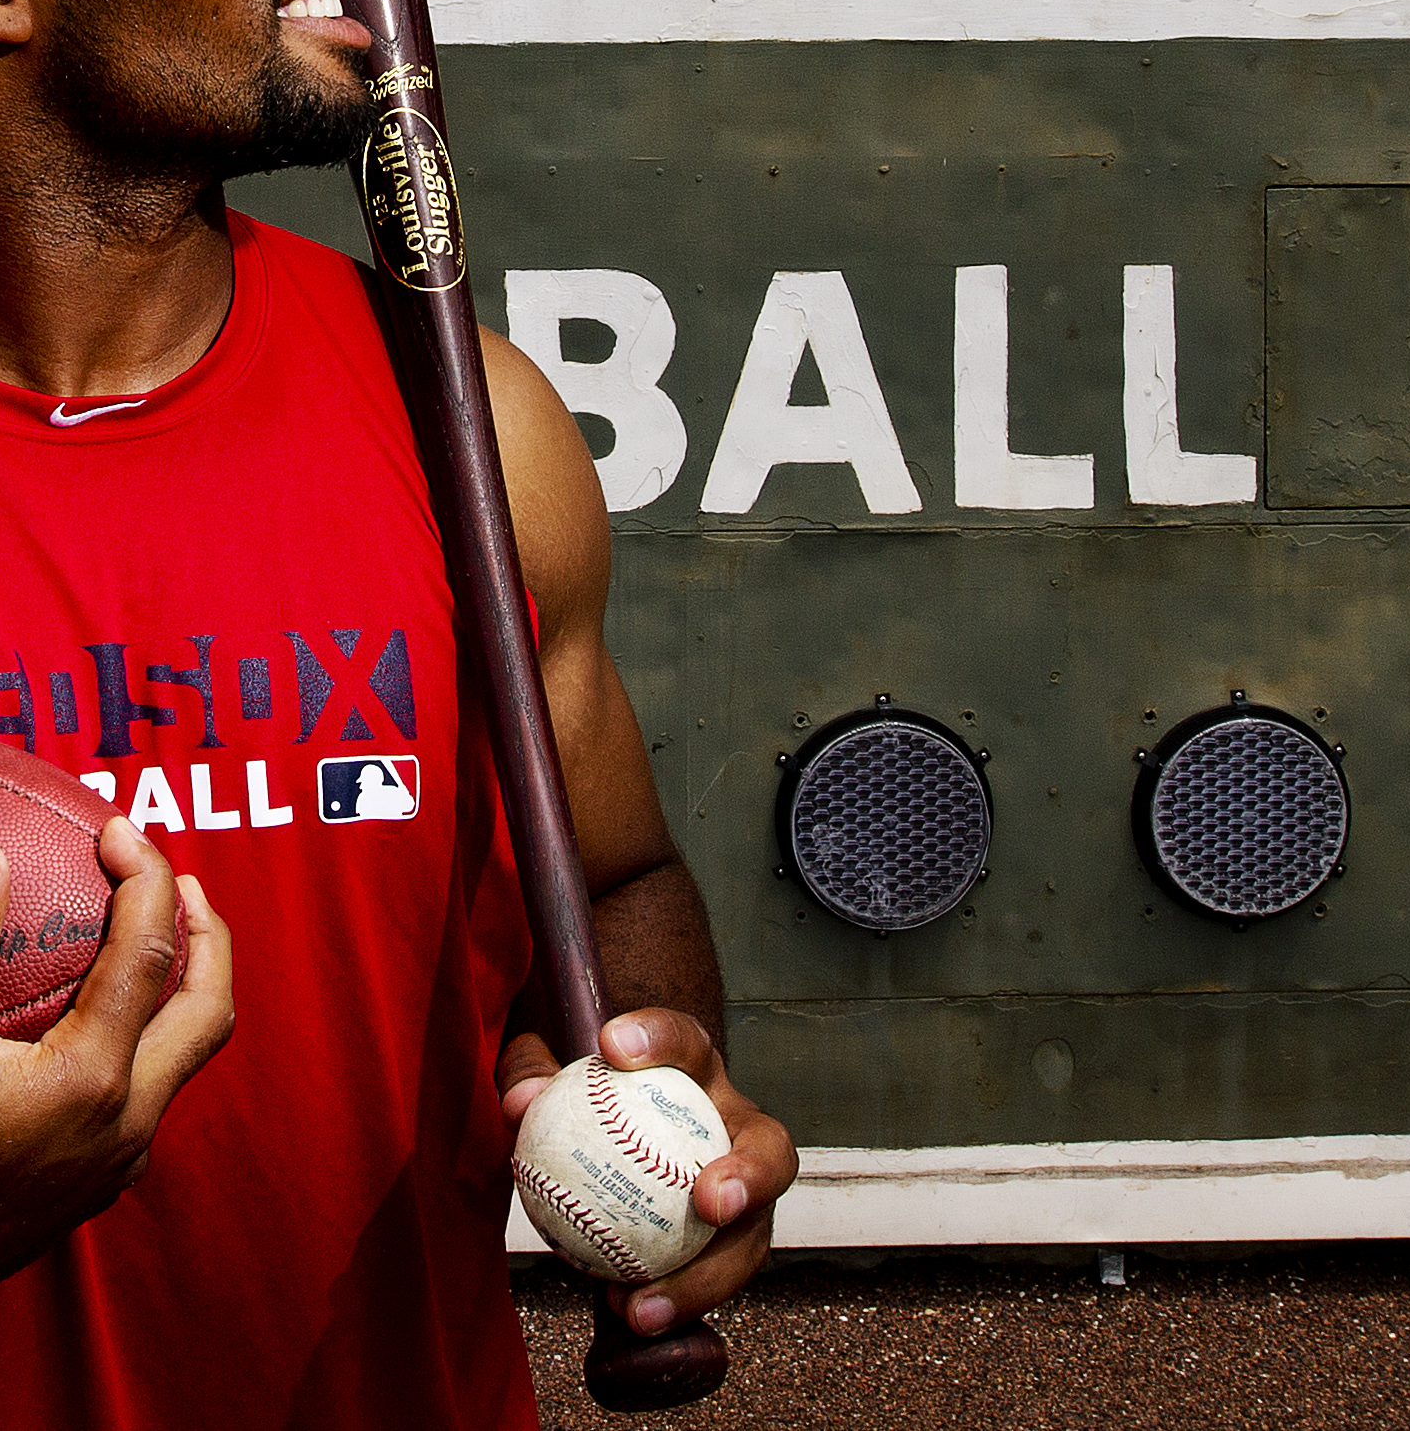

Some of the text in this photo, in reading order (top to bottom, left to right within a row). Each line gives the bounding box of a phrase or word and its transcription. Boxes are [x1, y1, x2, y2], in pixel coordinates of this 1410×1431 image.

[365, 66, 434, 103] werized
[374, 121, 431, 280] Louisville
[420, 141, 454, 257] Slugger
[504, 264, 1258, 515] BALL
[638, 1083, 711, 1141] Rawlings
[571, 1148, 603, 1179] MAJOR
[598, 1175, 633, 1205] LEAGUE
[628, 1199, 674, 1233] BASEBALL
[610, 1169, 646, 1200] OFFICIAL
